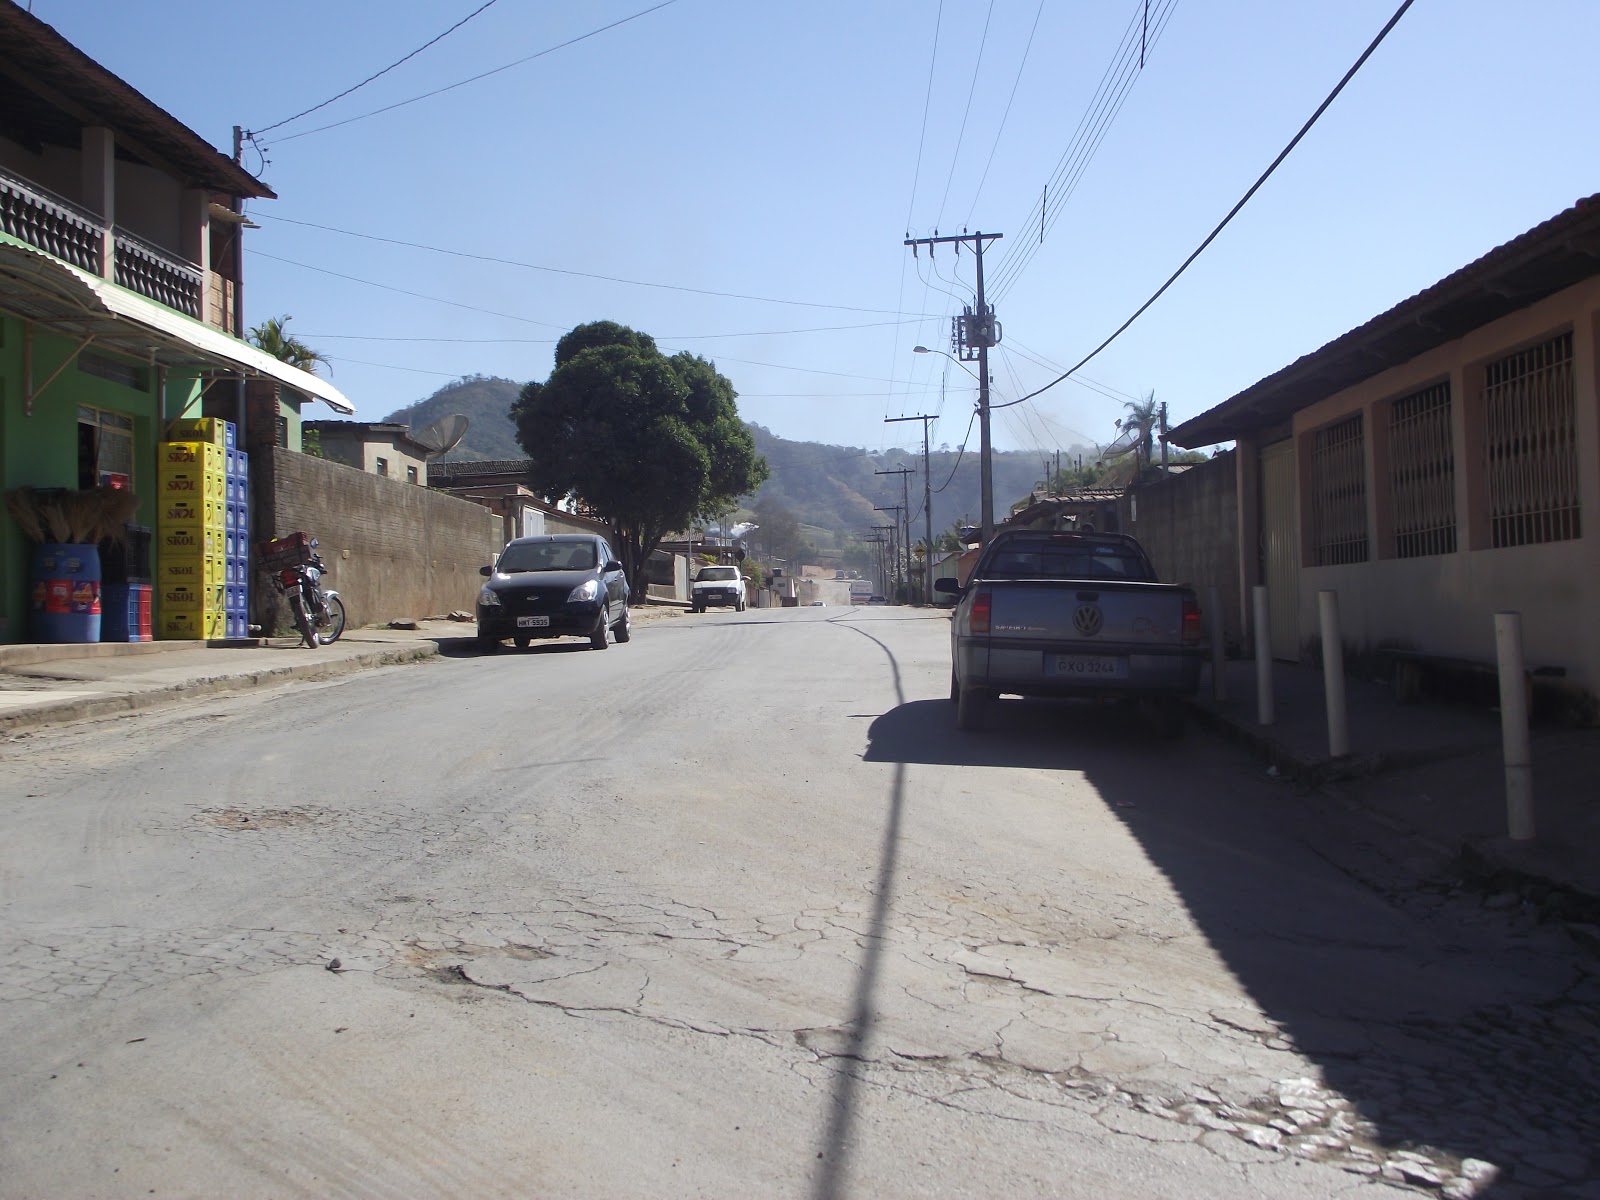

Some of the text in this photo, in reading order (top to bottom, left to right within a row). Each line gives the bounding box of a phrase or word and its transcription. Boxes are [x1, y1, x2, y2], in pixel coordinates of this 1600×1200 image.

[167, 452, 196, 464] SKOL
[167, 480, 196, 491] SKOL
[167, 508, 196, 520] SKOL
[166, 536, 196, 546] SKOL
[168, 566, 195, 575] SKOL
[165, 592, 196, 602] SKOL
